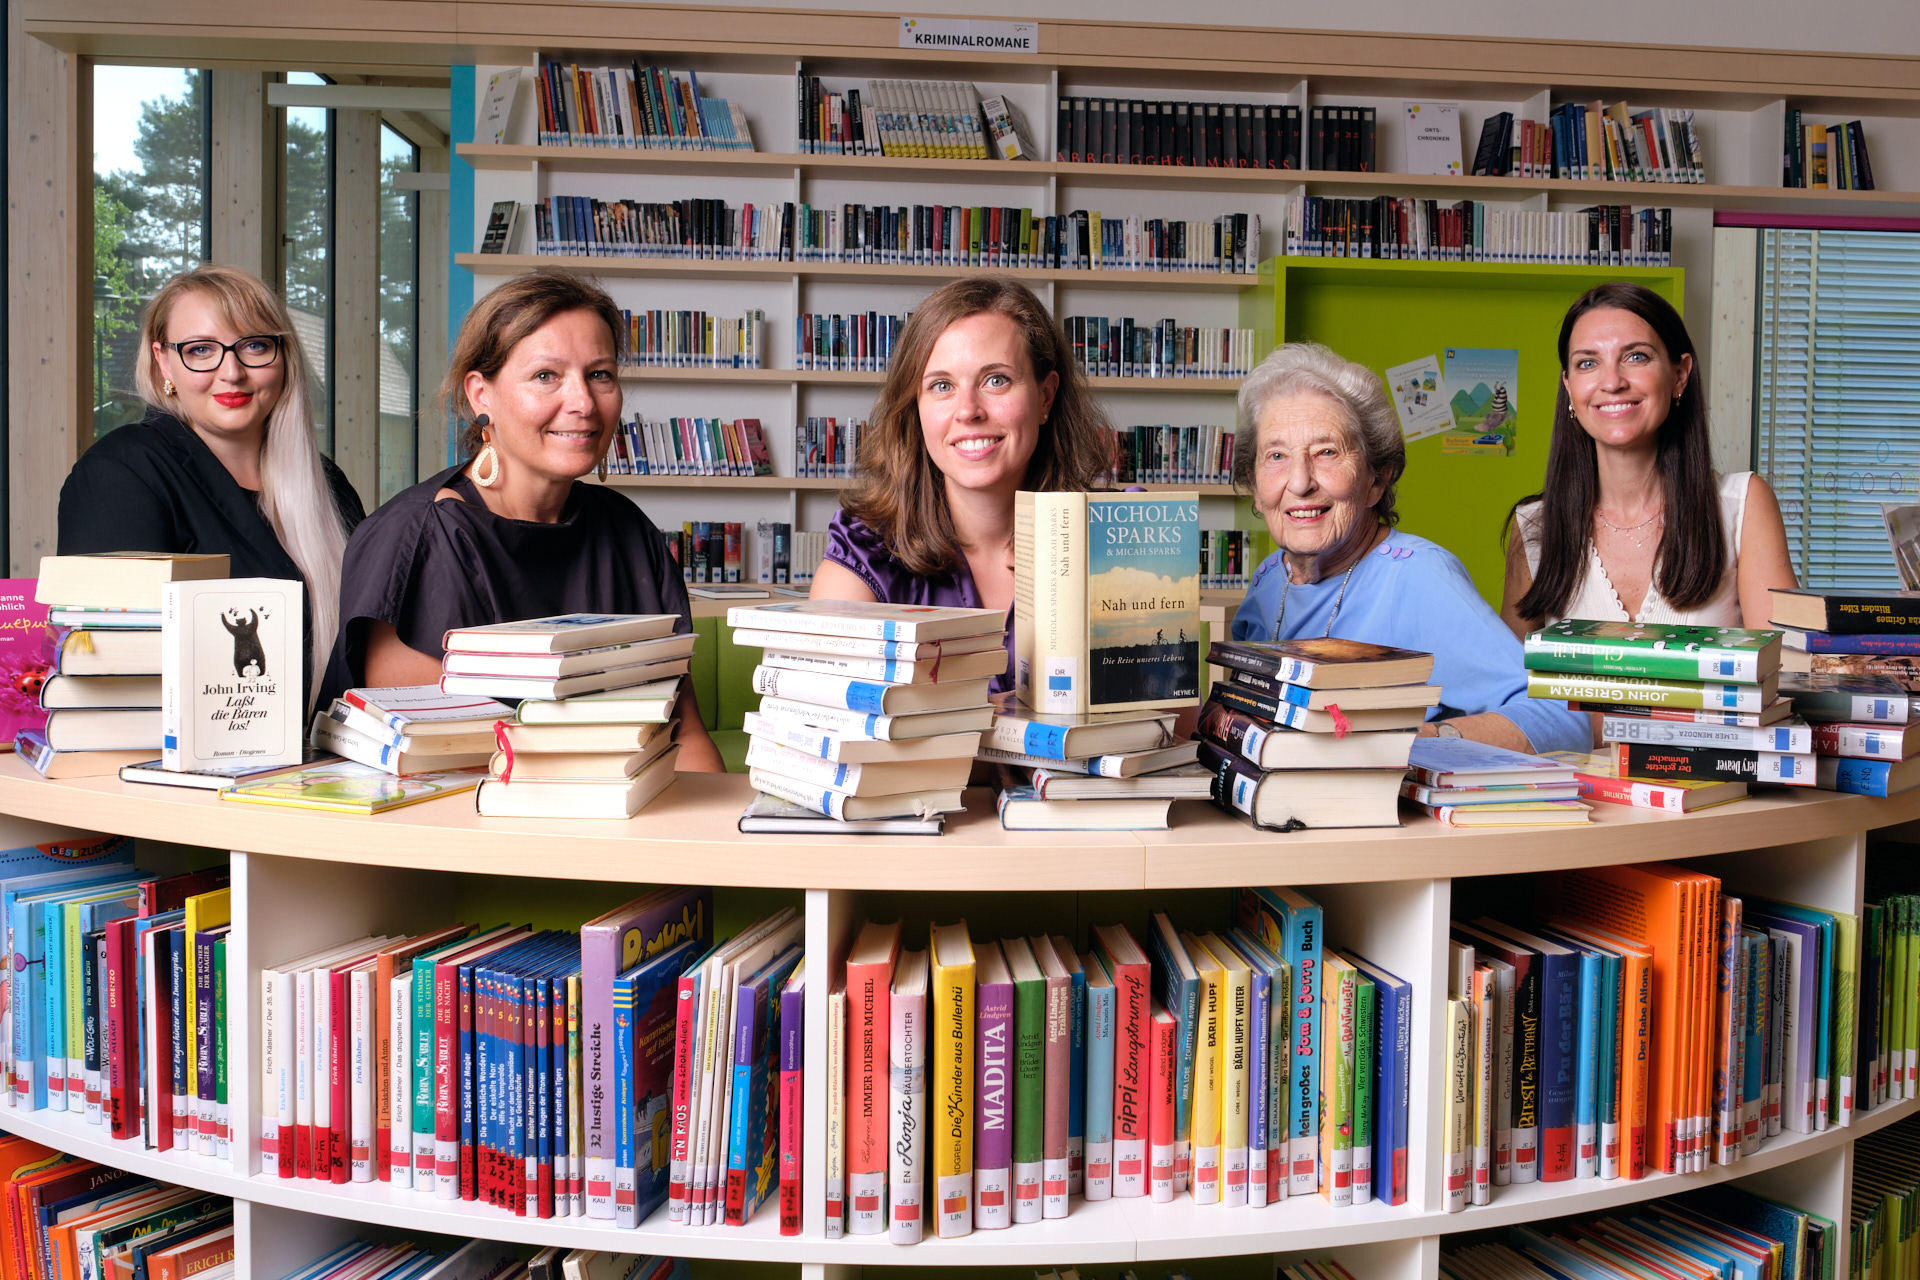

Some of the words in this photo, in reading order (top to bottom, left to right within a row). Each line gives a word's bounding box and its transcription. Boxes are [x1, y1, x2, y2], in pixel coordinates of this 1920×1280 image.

[915, 33, 1030, 49] KRIMINALROMANE
[1061, 508, 1070, 529] fern
[1089, 505, 1198, 523] NICHOLAS
[1061, 534, 1070, 556] und
[1106, 526, 1182, 544] SPARKS
[1115, 548, 1146, 556] MICAH
[1148, 547, 1181, 555] SPARKS
[1061, 559, 1070, 577] Nah
[1101, 599, 1127, 612] Nah
[1132, 598, 1156, 611] und
[1160, 597, 1185, 609] fern
[1861, 605, 1891, 614] Blinder
[1876, 615, 1906, 625] Grimes
[1102, 657, 1115, 665] Die
[1118, 656, 1134, 664] Reise
[1137, 656, 1160, 664] unseres
[1163, 654, 1185, 662] Lebens
[203, 684, 233, 695] John
[237, 683, 276, 695] Irving
[1550, 686, 1624, 701] GRISHAM
[1629, 691, 1669, 702] JOHN
[226, 696, 255, 708] Laßt
[211, 710, 230, 720] die
[232, 708, 268, 720] Bären
[228, 720, 250, 731] los!
[1679, 731, 1713, 739] MENDOZA
[1645, 763, 1676, 772] gehetzte
[1648, 755, 1689, 763] Uhrmacher
[1716, 759, 1740, 774] Deaver
[1773, 761, 1780, 772] DR
[1301, 920, 1313, 951] Buch
[171, 950, 183, 997] Immergrün
[1299, 959, 1315, 1003] Jerry
[1209, 983, 1217, 1012] HUPF
[1641, 967, 1649, 1006] Alfons
[172, 999, 180, 1016] dem
[488, 1008, 493, 1016] 4
[865, 979, 874, 1025] MICHEL
[1058, 987, 1068, 1036] Erzählungen
[1236, 986, 1244, 1016] WEITER
[1398, 997, 1406, 1024] McKay
[508, 1014, 513, 1022] 6
[528, 1018, 532, 1026] 8
[952, 986, 963, 1040] Bullerbü
[1297, 1008, 1311, 1018] &
[1359, 996, 1367, 1037] Schwestern
[172, 1018, 181, 1041] hinter
[1049, 1021, 1058, 1043] Astrid
[1124, 975, 1144, 1085] Langstrumpf
[1208, 1017, 1216, 1046] BÄRLI
[1235, 1019, 1244, 1043] HUPFT
[1638, 1009, 1647, 1042] Rabe
[679, 1019, 688, 1078] Schoko-Aliens
[864, 1029, 873, 1073] DIESER
[1297, 1023, 1311, 1056] Tom
[1520, 1012, 1537, 1072] BETHANY
[172, 1043, 184, 1064] Engel
[591, 1023, 601, 1080] Streiche
[904, 1012, 913, 1095] RÄUBERTOCHTER
[954, 1042, 963, 1065] aus
[1234, 1046, 1243, 1069] BÄRLI
[1357, 1040, 1366, 1074] verrückte
[983, 1022, 1006, 1131] MADITA
[1357, 1076, 1366, 1090] Vier
[381, 1078, 389, 1114] Pünktchen
[864, 1075, 873, 1118] IMMER
[948, 1065, 964, 1117] Kinder
[591, 1085, 604, 1128] lustige
[1518, 1080, 1535, 1128] BIEST
[676, 1104, 687, 1134] KAOS
[951, 1117, 962, 1138] Die
[591, 1131, 602, 1148] 32
[897, 1095, 916, 1167] Ronja
[90, 1168, 131, 1189] JANO
[1451, 1190, 1464, 1198] MAY
[42, 1225, 50, 1260] Hannes
[186, 1252, 226, 1275] ERICH
